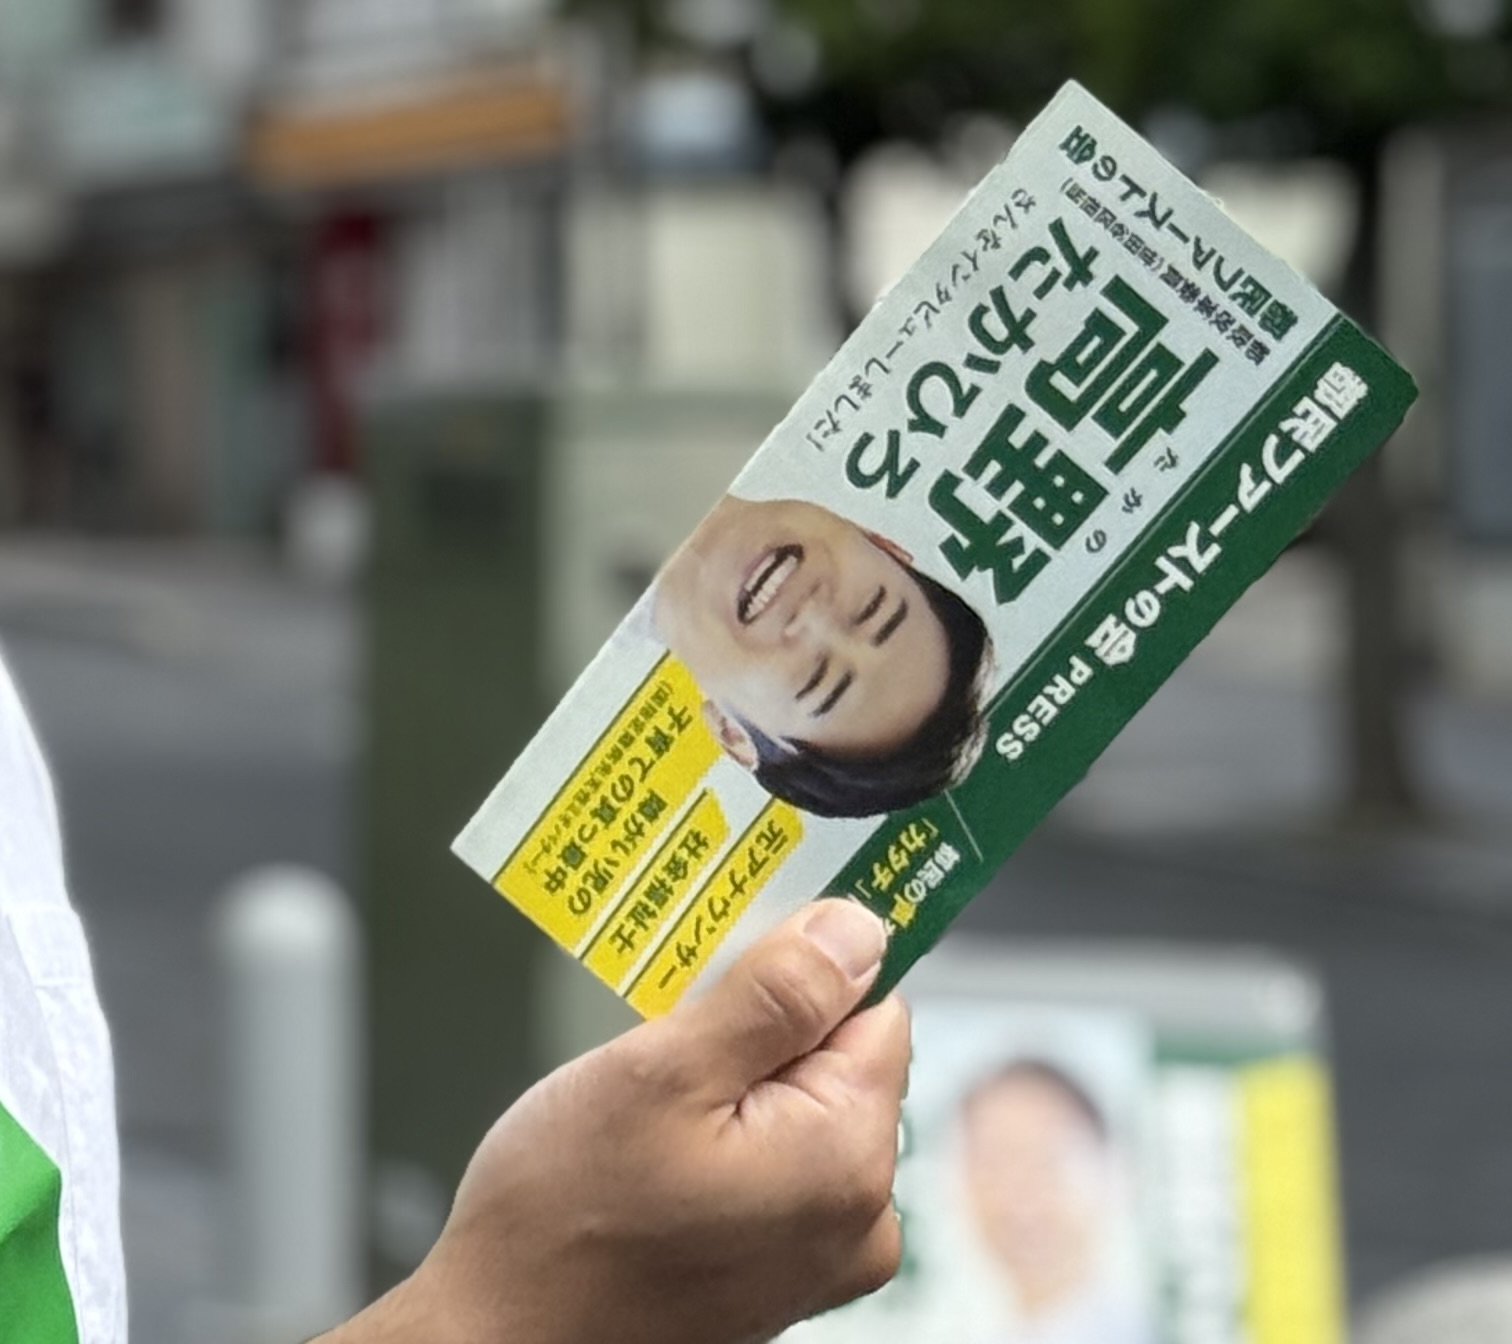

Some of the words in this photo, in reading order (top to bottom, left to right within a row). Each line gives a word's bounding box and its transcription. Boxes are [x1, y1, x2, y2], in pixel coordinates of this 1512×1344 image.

[1058, 124, 1299, 342] 都民ファーストの会
[844, 216, 1100, 499] たかひろ
[927, 273, 1220, 605] 高野
[1083, 360, 1368, 666] 都民ファーストの会
[994, 654, 1093, 760] PRESS
[608, 828, 710, 954] 社会福祉士
[658, 817, 789, 989] 元アナウンサー
[845, 818, 939, 903] 「カタチ」
